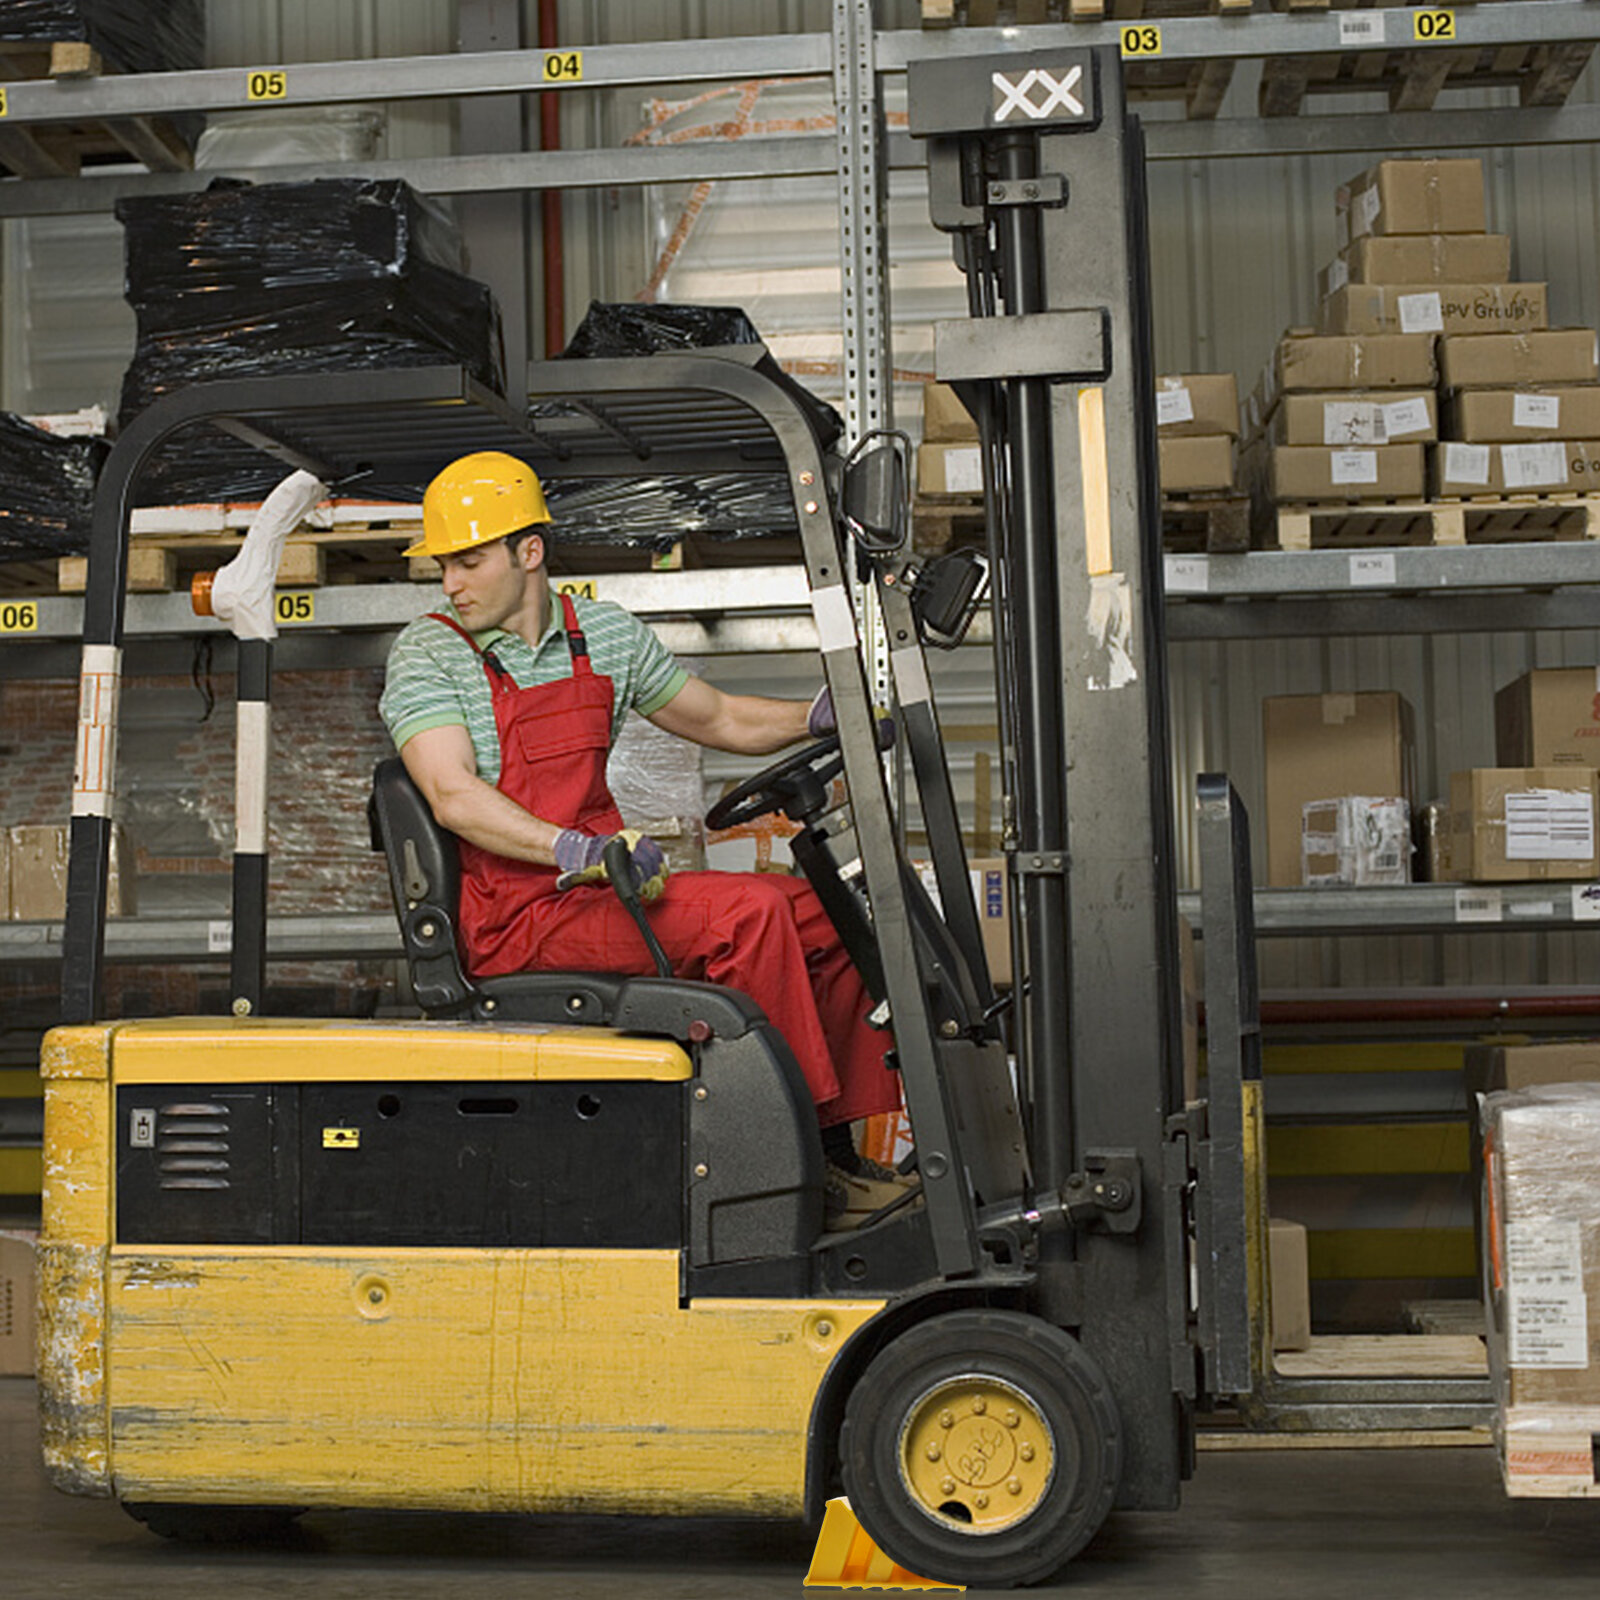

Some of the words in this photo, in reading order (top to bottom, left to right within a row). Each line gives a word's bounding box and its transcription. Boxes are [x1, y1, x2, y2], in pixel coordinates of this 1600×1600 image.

[1417, 13, 1452, 37] 02
[1124, 29, 1158, 52] 03
[546, 54, 579, 78] 04
[251, 74, 283, 97] 05
[2, 605, 34, 629] 06
[278, 595, 311, 619] 05
